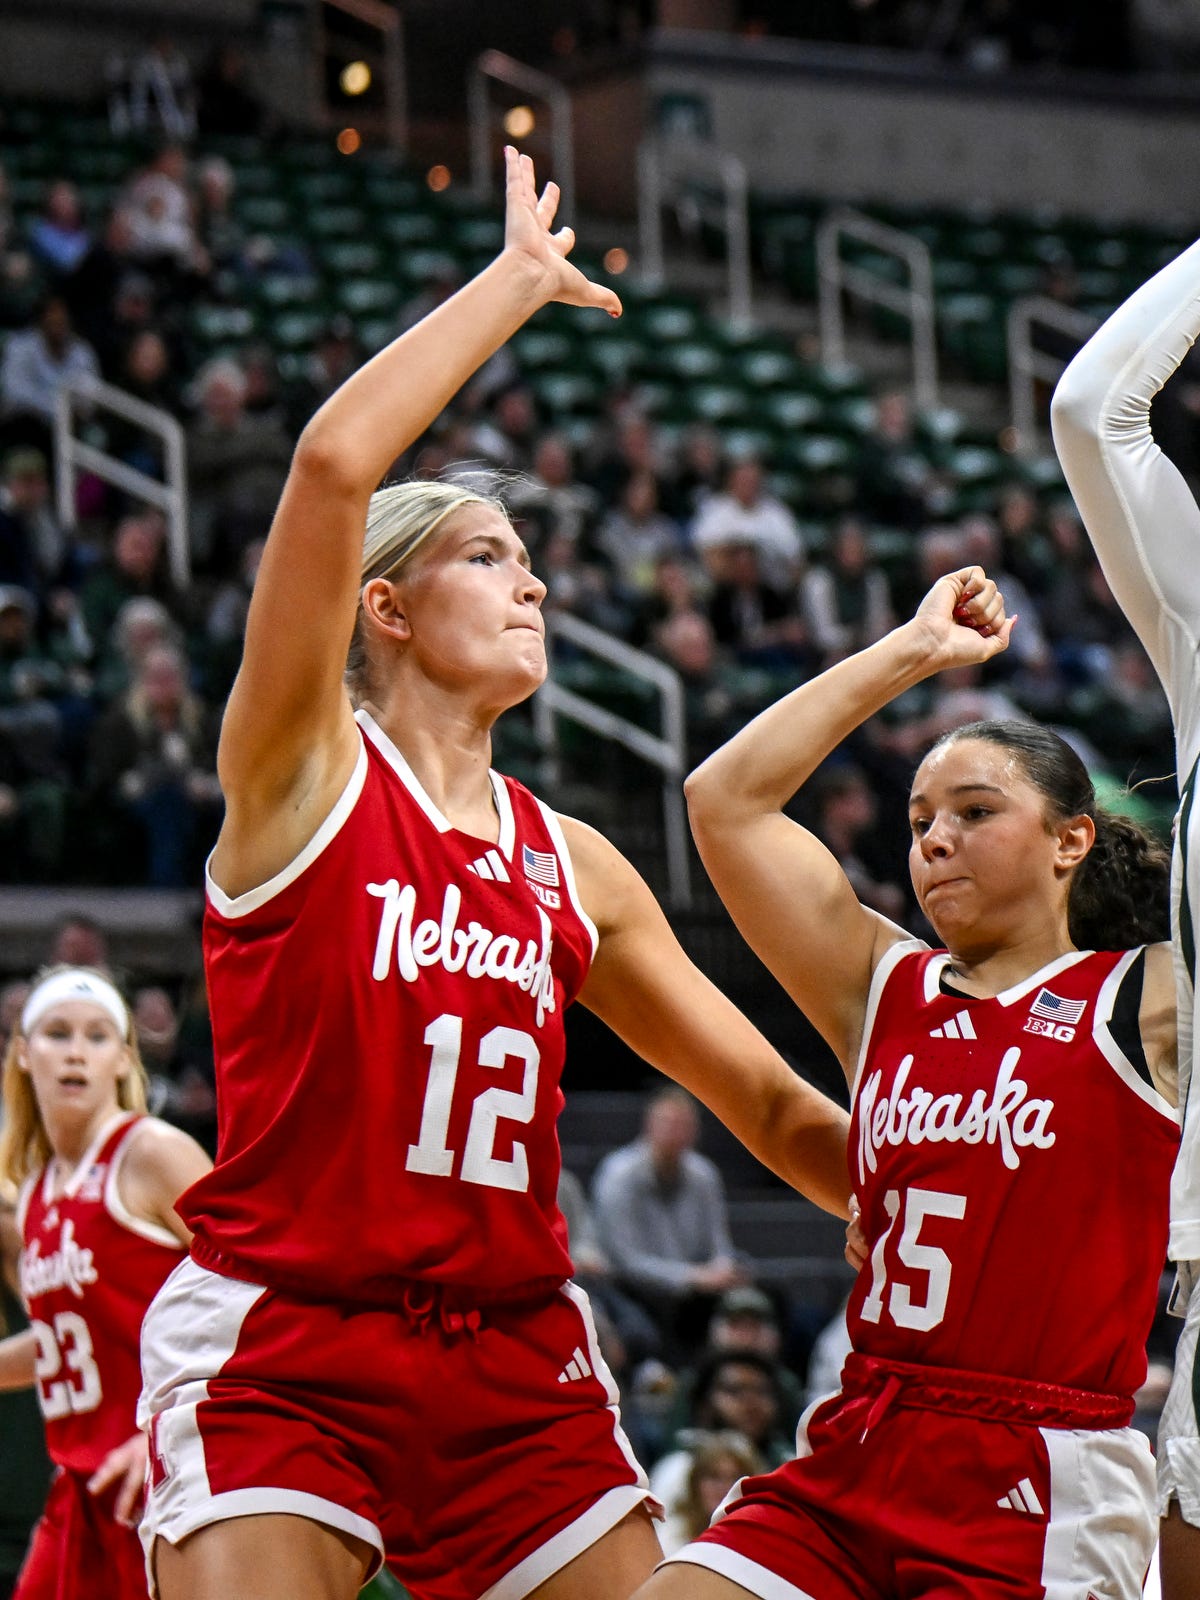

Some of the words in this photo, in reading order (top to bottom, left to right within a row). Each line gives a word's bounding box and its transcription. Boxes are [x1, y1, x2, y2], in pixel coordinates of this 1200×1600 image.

[404, 1012, 541, 1194] 12
[857, 1046, 1057, 1186] Nebraska
[859, 1186, 968, 1333] 15
[32, 1311, 104, 1422] 23
